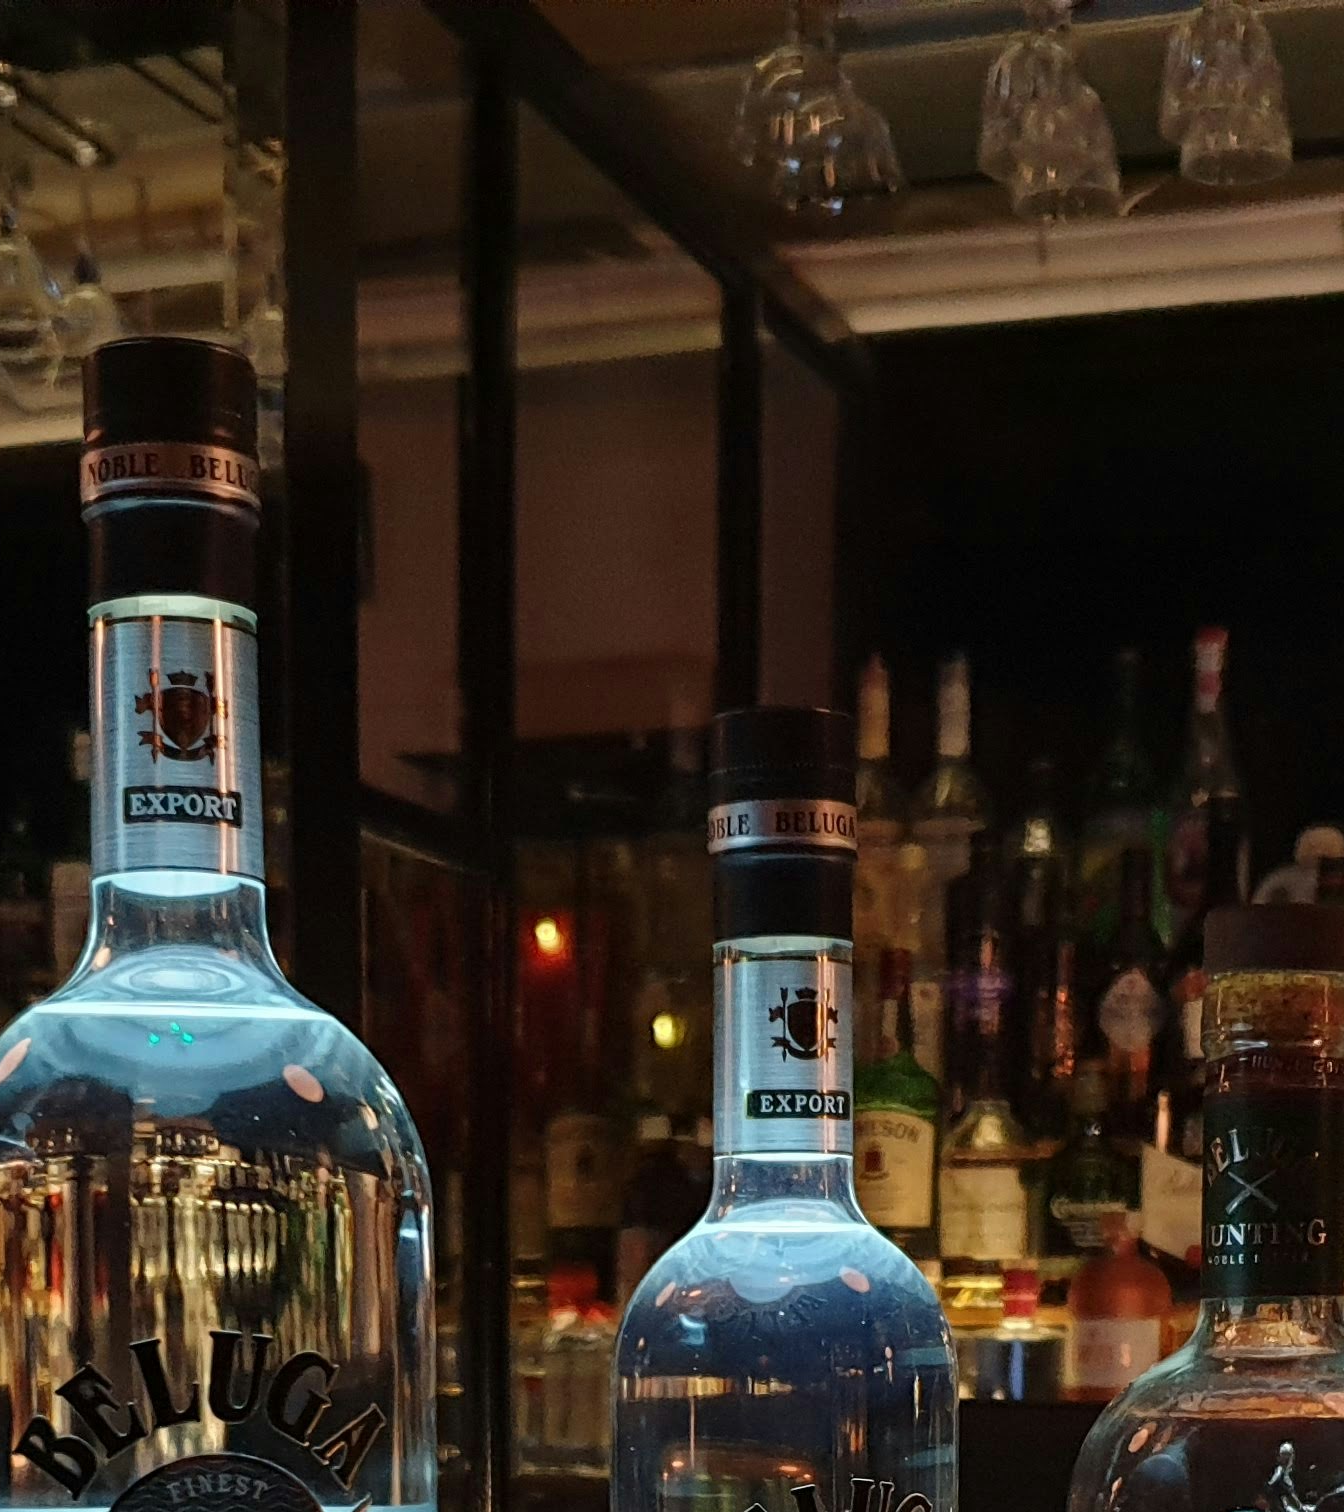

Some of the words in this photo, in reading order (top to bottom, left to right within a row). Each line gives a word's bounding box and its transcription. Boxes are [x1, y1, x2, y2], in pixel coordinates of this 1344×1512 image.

[129, 793, 237, 820] EXPORT
[774, 811, 856, 838] BELUGA
[760, 1094, 845, 1114] EXPORT
[13, 1330, 387, 1501] BELUGA
[166, 1475, 270, 1504] FINEST
